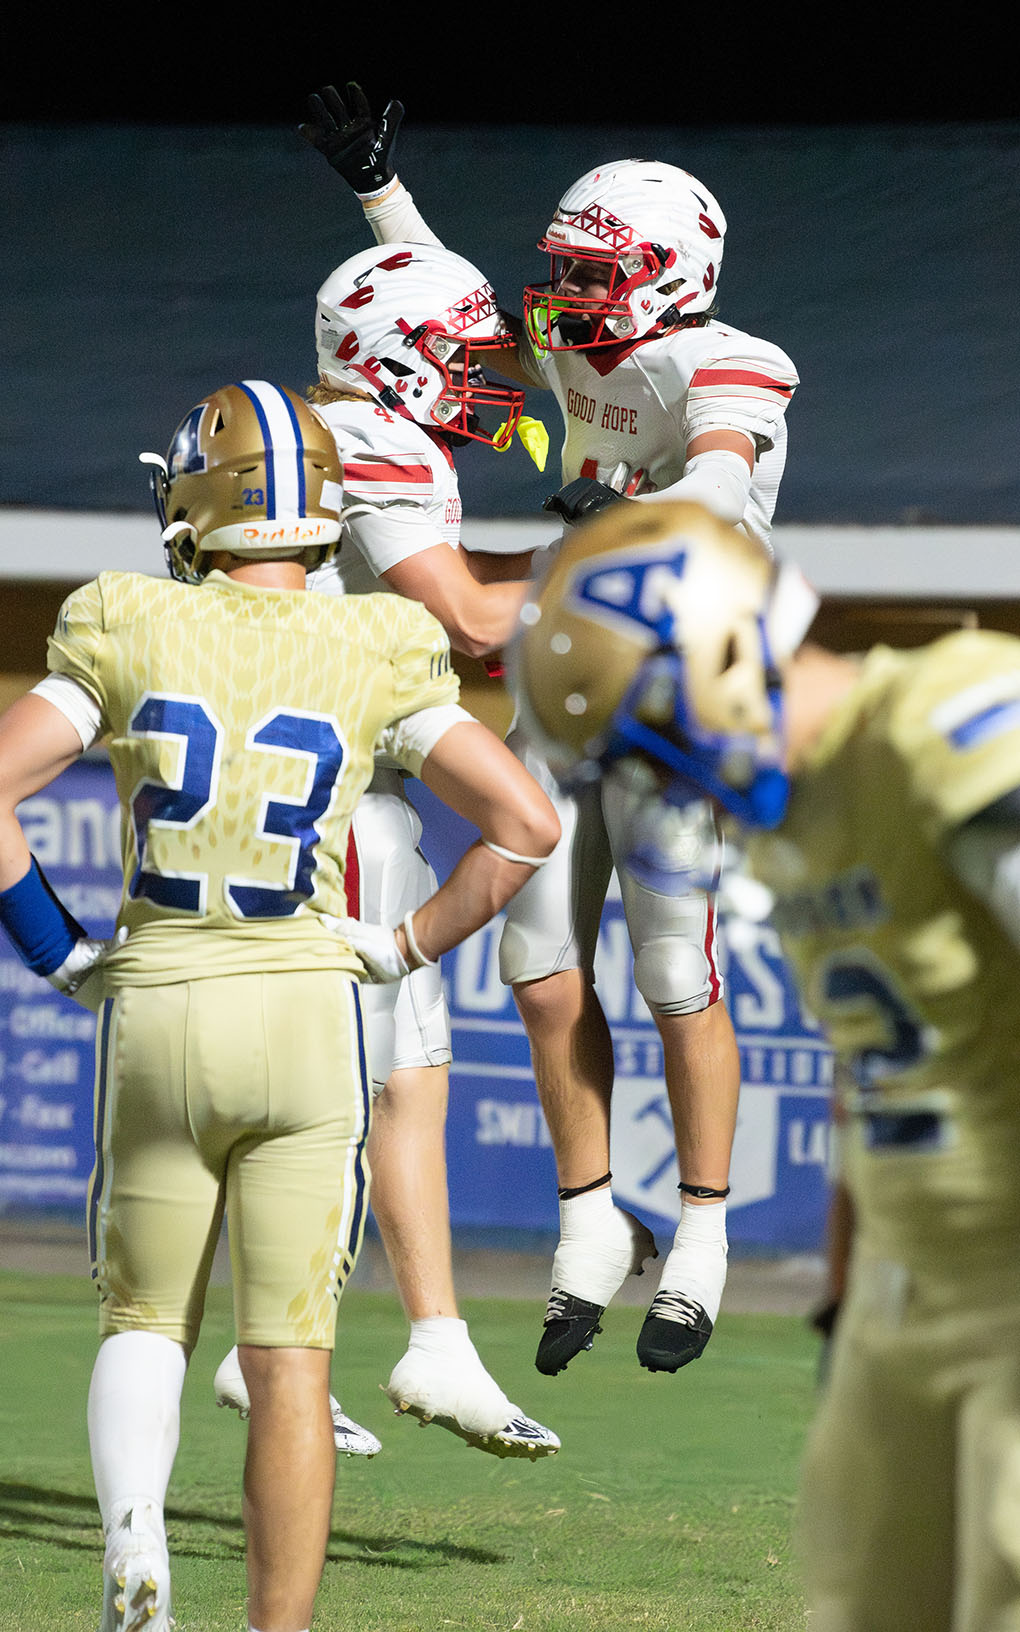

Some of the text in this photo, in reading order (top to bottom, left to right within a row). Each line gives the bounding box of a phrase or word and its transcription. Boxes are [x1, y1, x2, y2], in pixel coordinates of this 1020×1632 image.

[567, 387, 638, 435] GOOD HOPE
[242, 488, 264, 506] 23
[127, 691, 348, 921] 23
